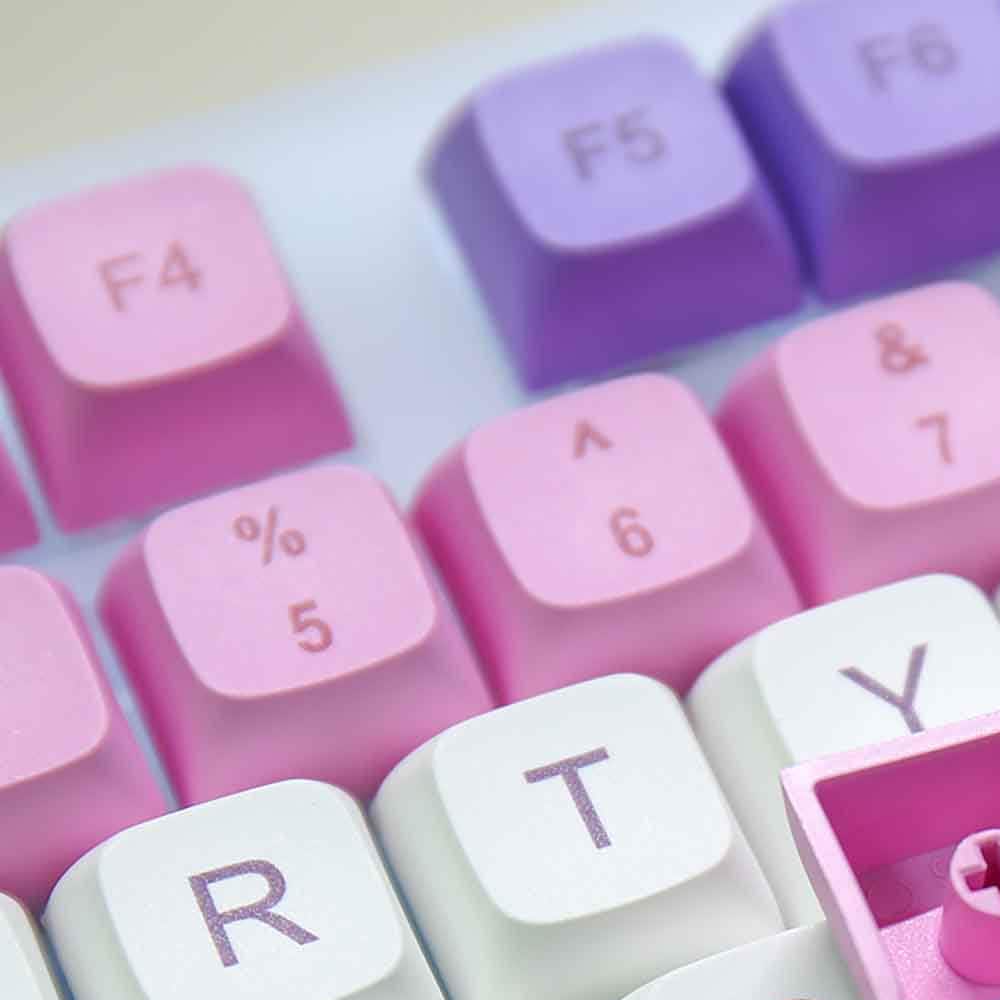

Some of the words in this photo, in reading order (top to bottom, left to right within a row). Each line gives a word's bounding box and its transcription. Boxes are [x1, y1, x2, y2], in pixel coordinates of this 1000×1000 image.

[857, 23, 957, 90] F6
[561, 108, 667, 180] F5
[97, 240, 203, 312] F4
[875, 322, 928, 376] &
[916, 413, 952, 464] 7
[233, 506, 306, 566] %
[608, 507, 654, 558] 6
[288, 600, 333, 653] 5
[838, 642, 928, 734] Y
[523, 747, 611, 849] T
[188, 859, 320, 967] R
